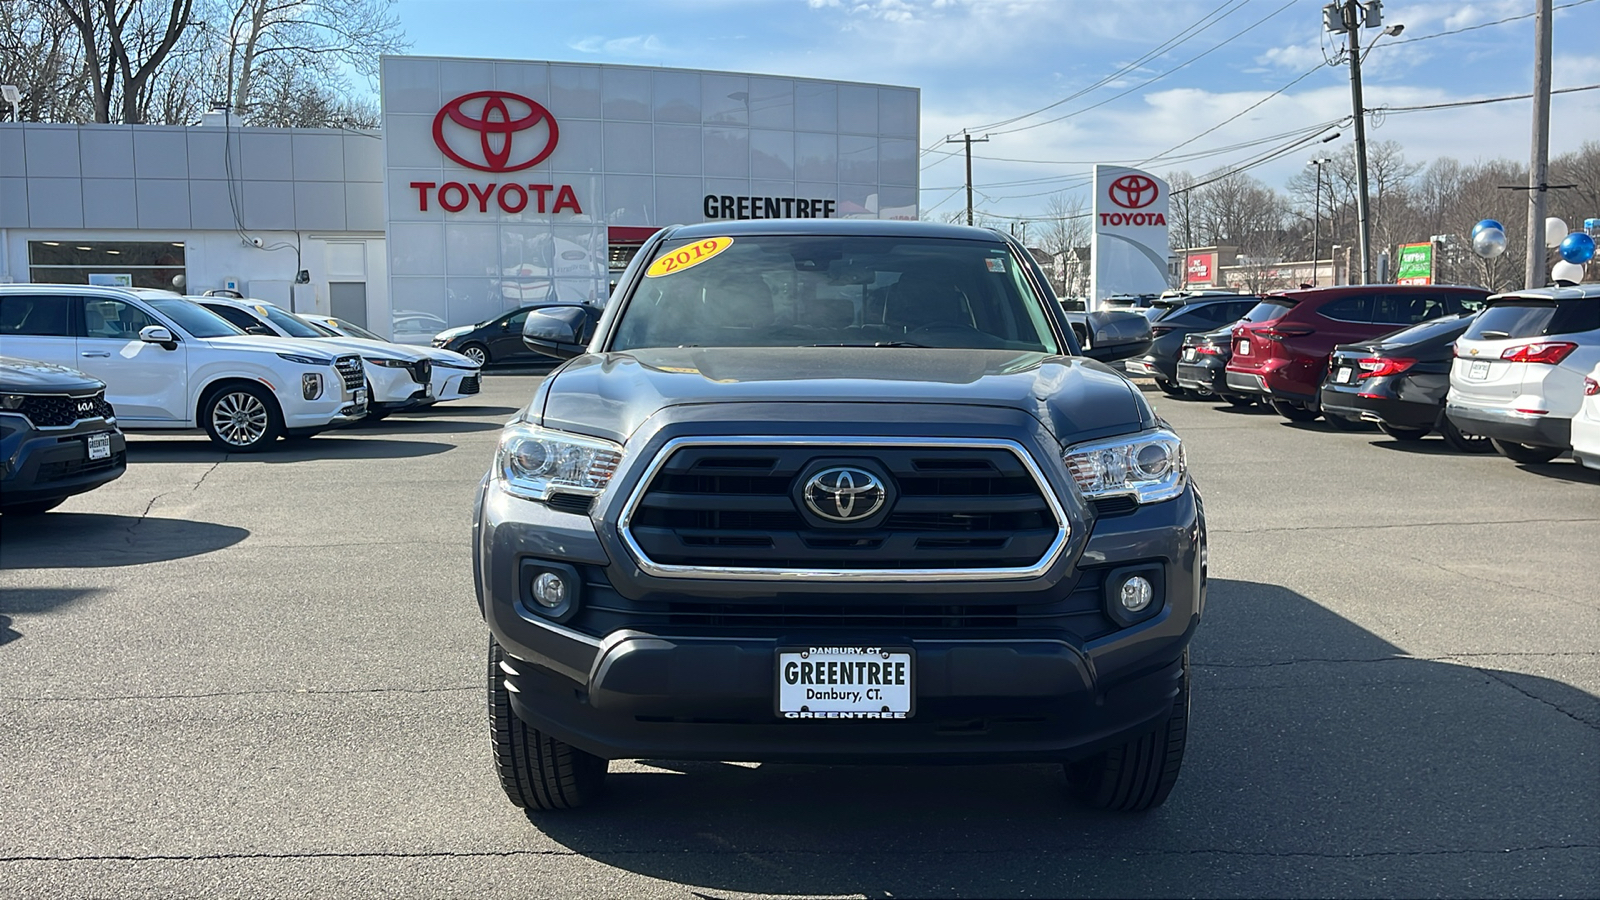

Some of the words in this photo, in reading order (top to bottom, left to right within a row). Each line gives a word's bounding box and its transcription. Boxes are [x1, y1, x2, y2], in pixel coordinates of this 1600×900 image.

[410, 181, 583, 214] TOYOTA
[703, 194, 836, 219] GREENTREE
[1099, 212, 1167, 226] TOYOTA
[662, 240, 718, 272] 2019
[809, 647, 864, 655] DANBURY,
[866, 647, 882, 655] CT
[785, 662, 905, 685] GREENTREE
[806, 687, 862, 703] Danbury,
[866, 688, 883, 701] CT.
